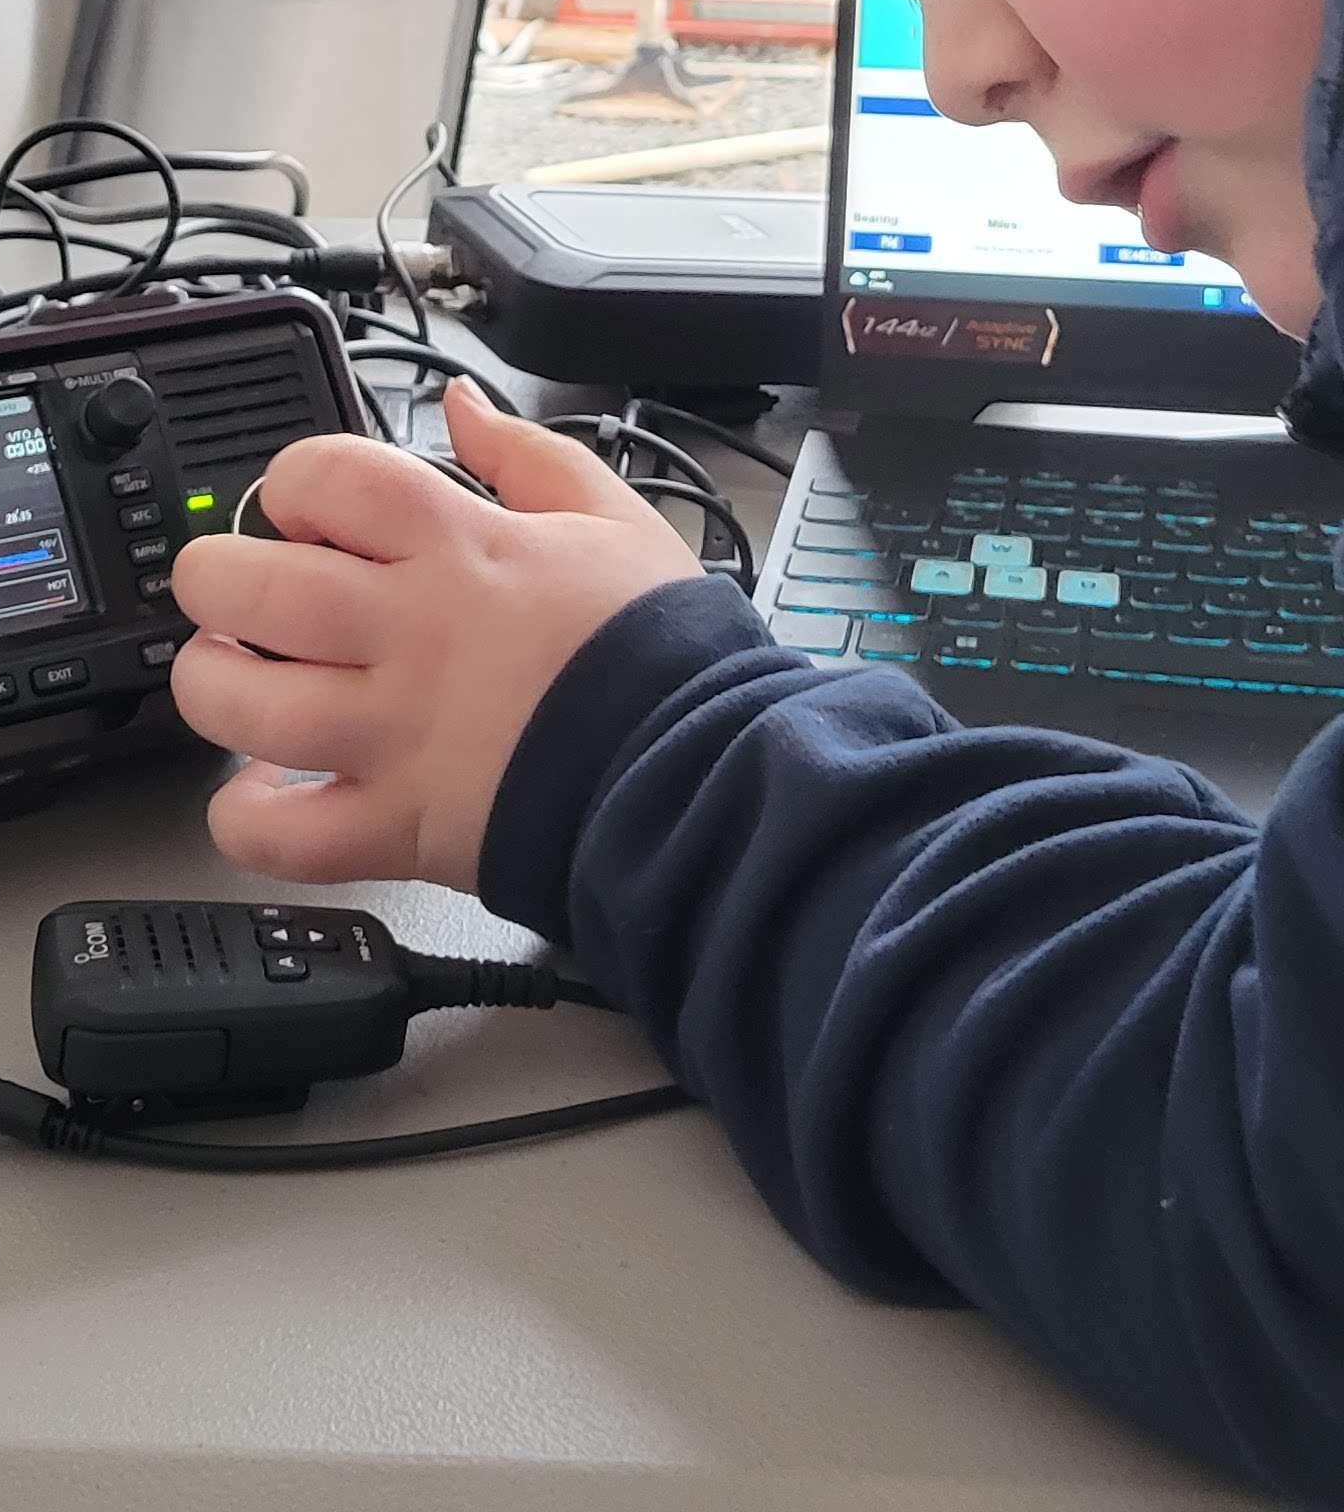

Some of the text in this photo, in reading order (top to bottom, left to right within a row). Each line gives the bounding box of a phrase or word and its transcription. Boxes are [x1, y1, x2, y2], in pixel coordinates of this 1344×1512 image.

[976, 335, 1032, 351] SYNC
[48, 579, 68, 591] HOT
[48, 666, 73, 682] EXIT
